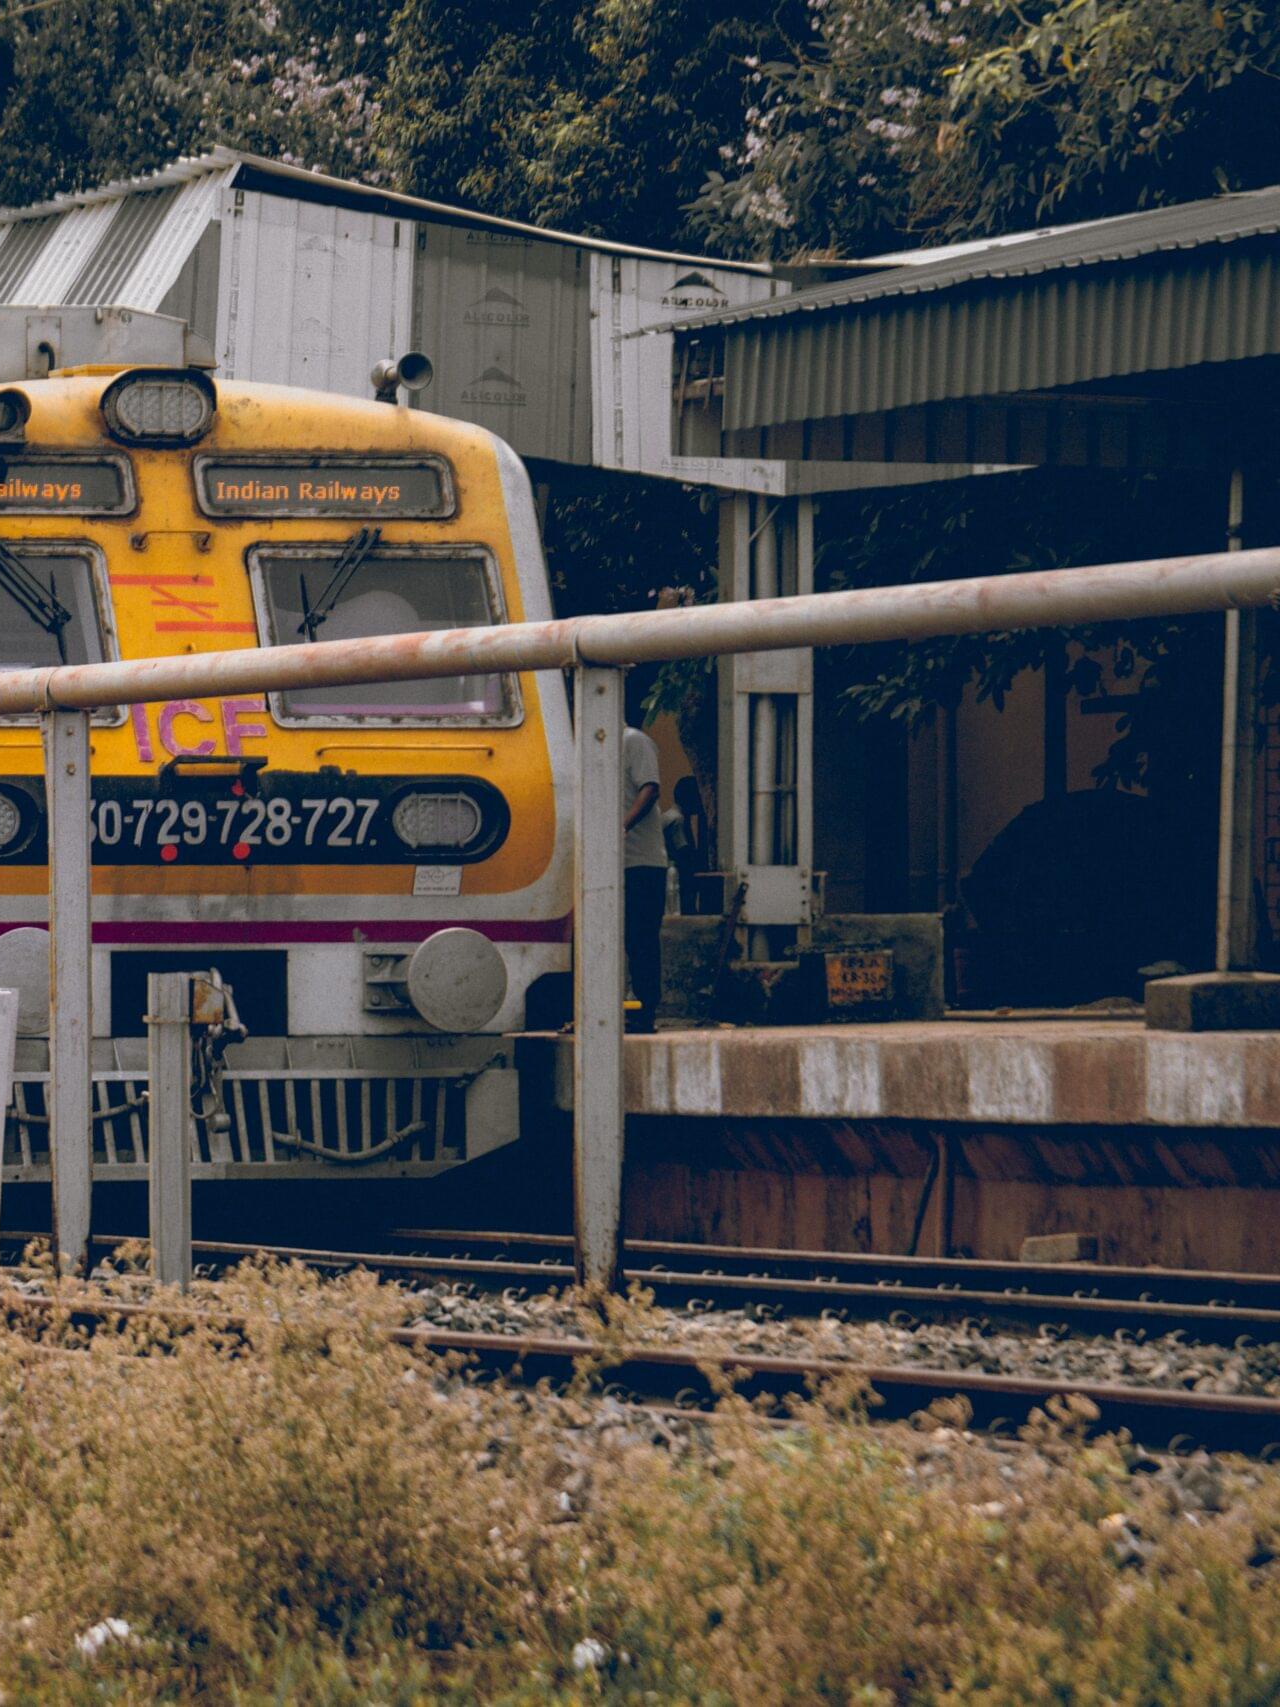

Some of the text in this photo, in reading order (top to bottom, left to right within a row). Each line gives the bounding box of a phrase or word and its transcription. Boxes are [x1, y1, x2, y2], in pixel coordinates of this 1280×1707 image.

[217, 480, 401, 505] Indian Railways
[131, 698, 268, 762] ICF
[90, 798, 380, 847] 0-729-728-727.
